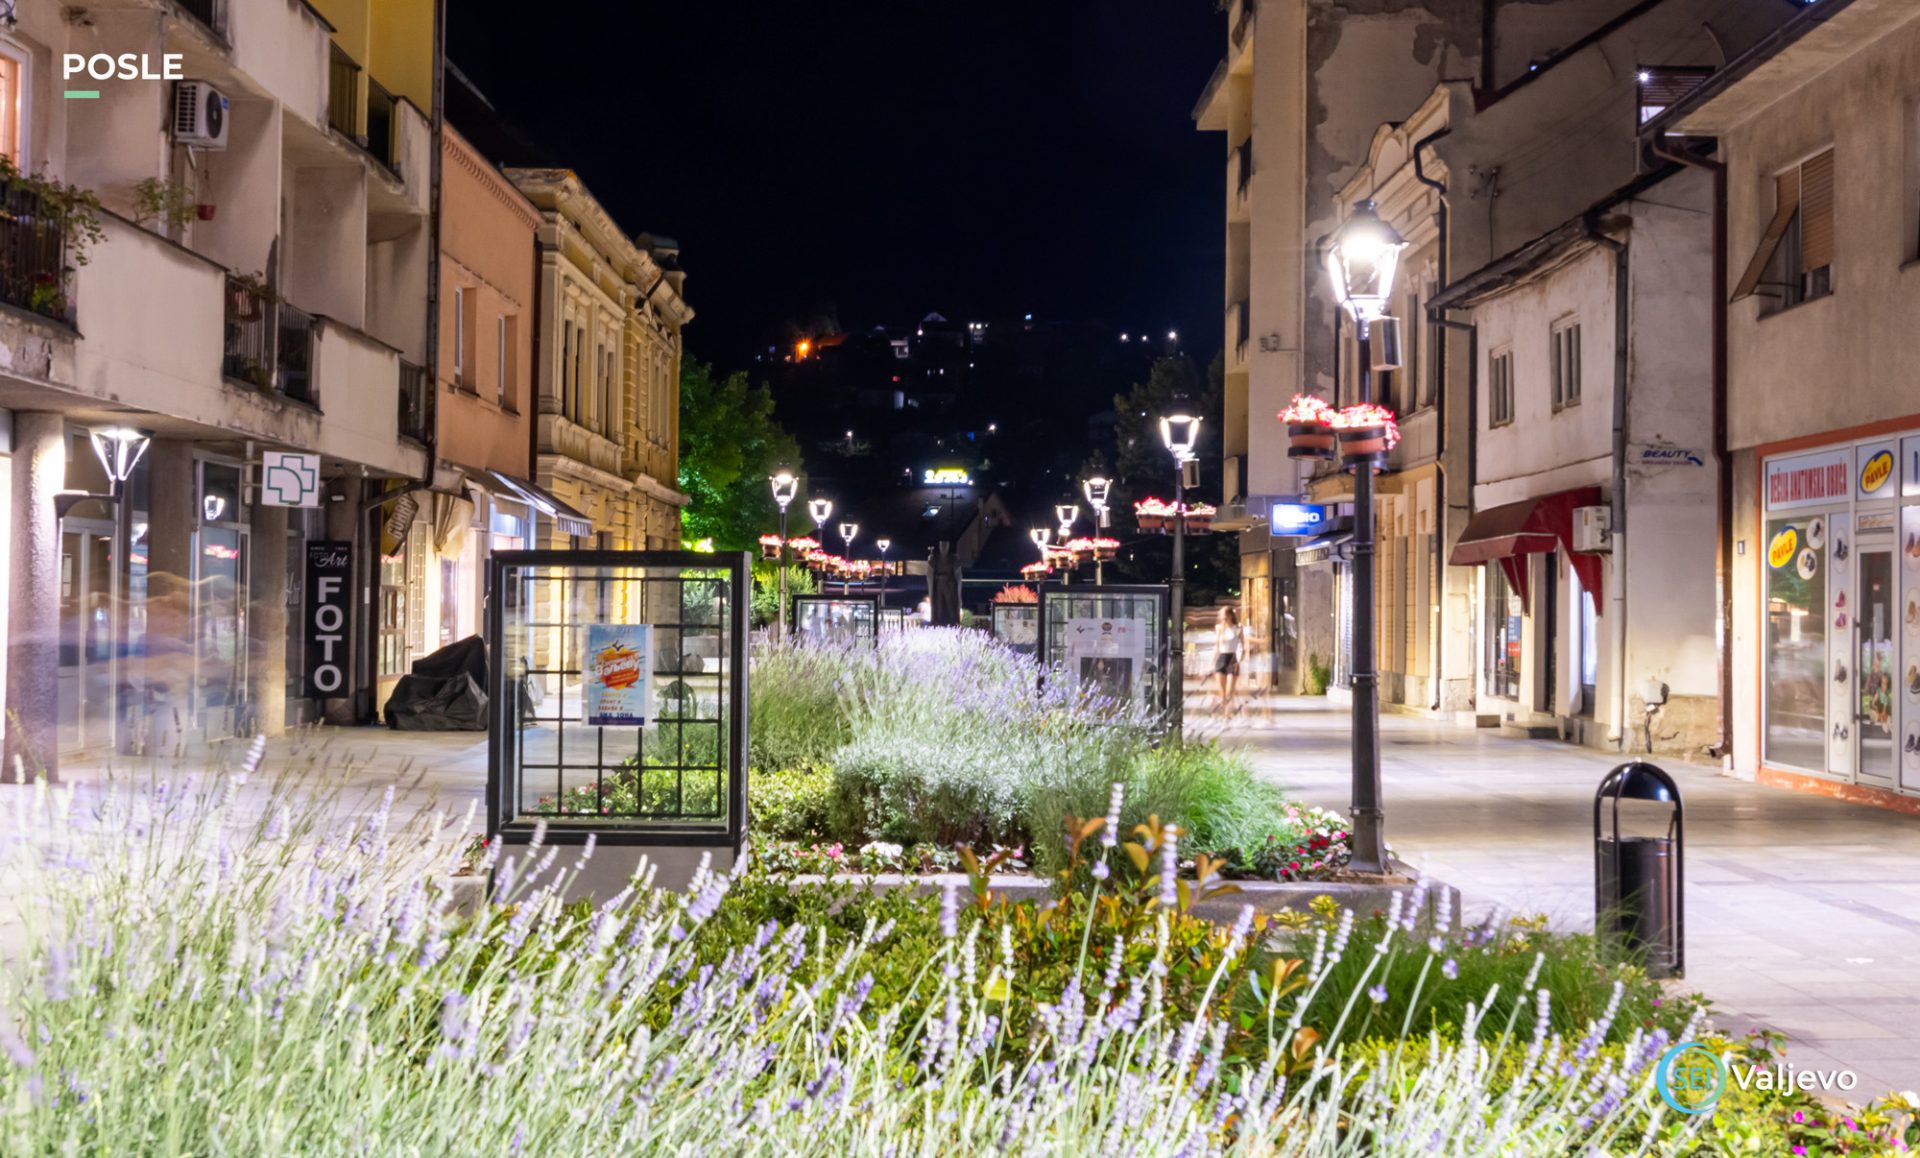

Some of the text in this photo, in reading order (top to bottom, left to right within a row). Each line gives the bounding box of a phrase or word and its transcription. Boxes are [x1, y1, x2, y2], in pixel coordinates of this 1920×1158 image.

[1643, 449, 1691, 458] BEAUTY
[1865, 461, 1888, 488] PAVLE
[314, 552, 348, 568] Art
[1772, 538, 1793, 562] PAVLE
[313, 576, 343, 692] FOTO
